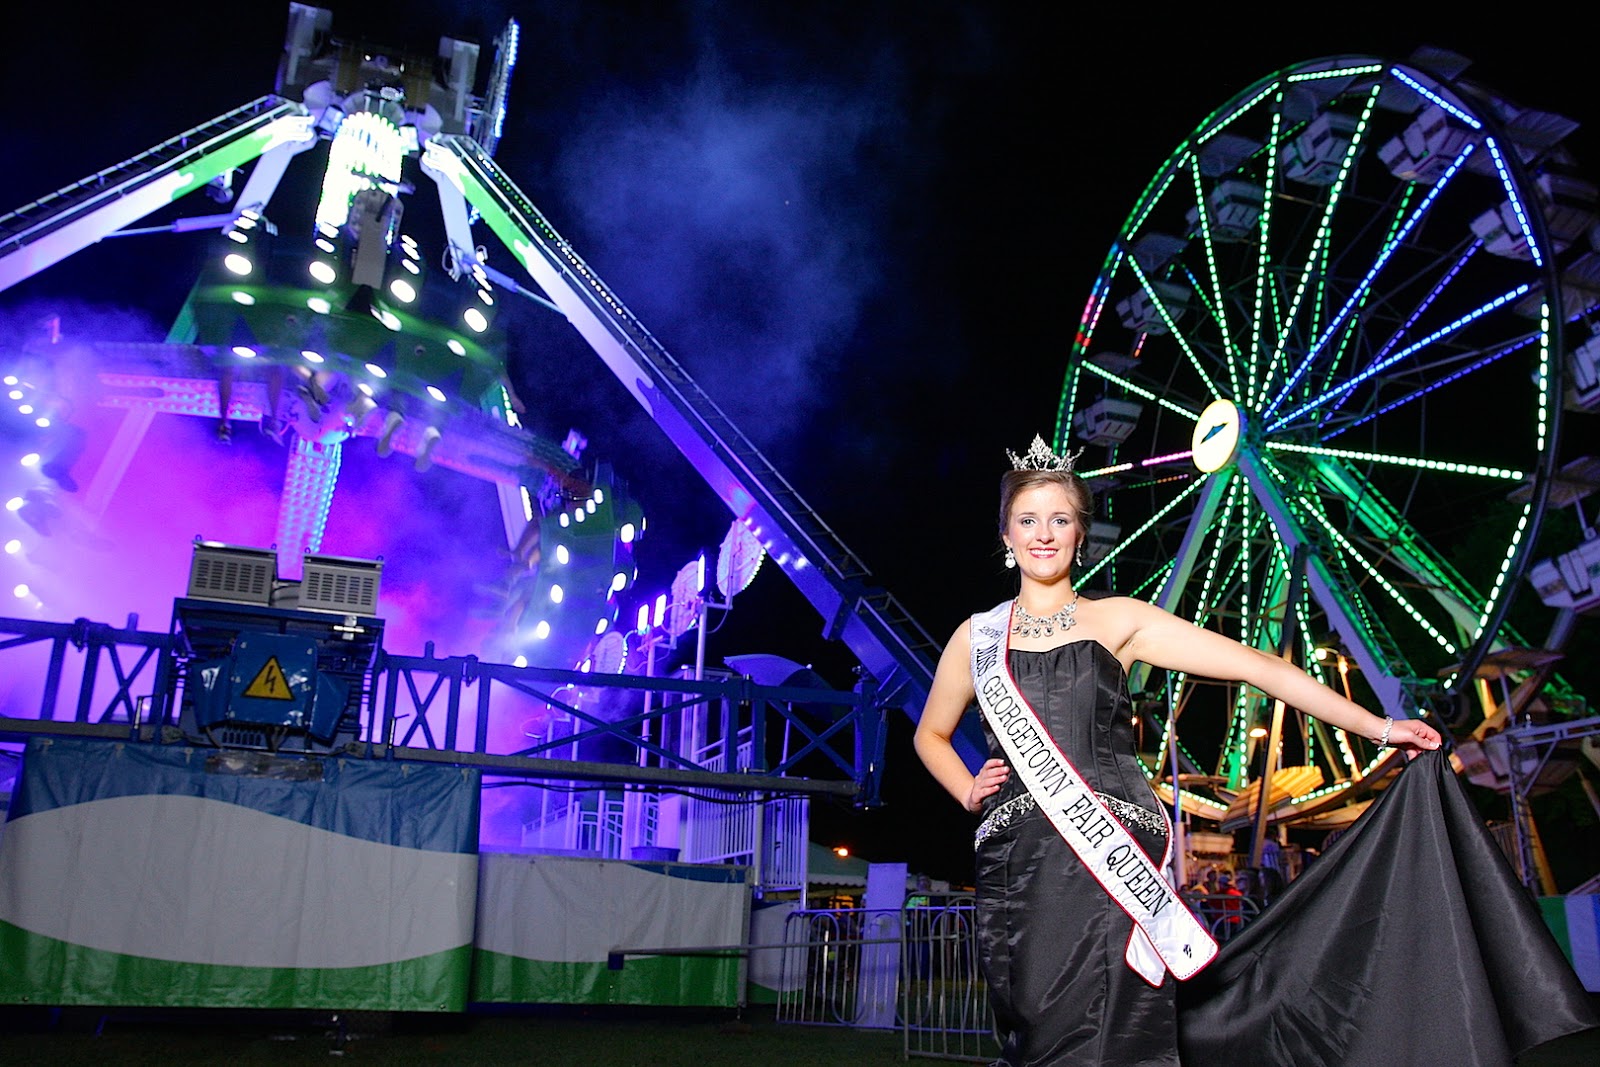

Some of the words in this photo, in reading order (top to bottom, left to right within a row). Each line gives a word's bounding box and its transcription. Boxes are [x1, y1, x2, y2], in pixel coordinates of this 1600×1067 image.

[976, 641, 998, 678] MISS
[982, 675, 1074, 798] GEORGETOWN
[1062, 794, 1114, 849] FAIR
[1106, 844, 1173, 918] QUEEN
